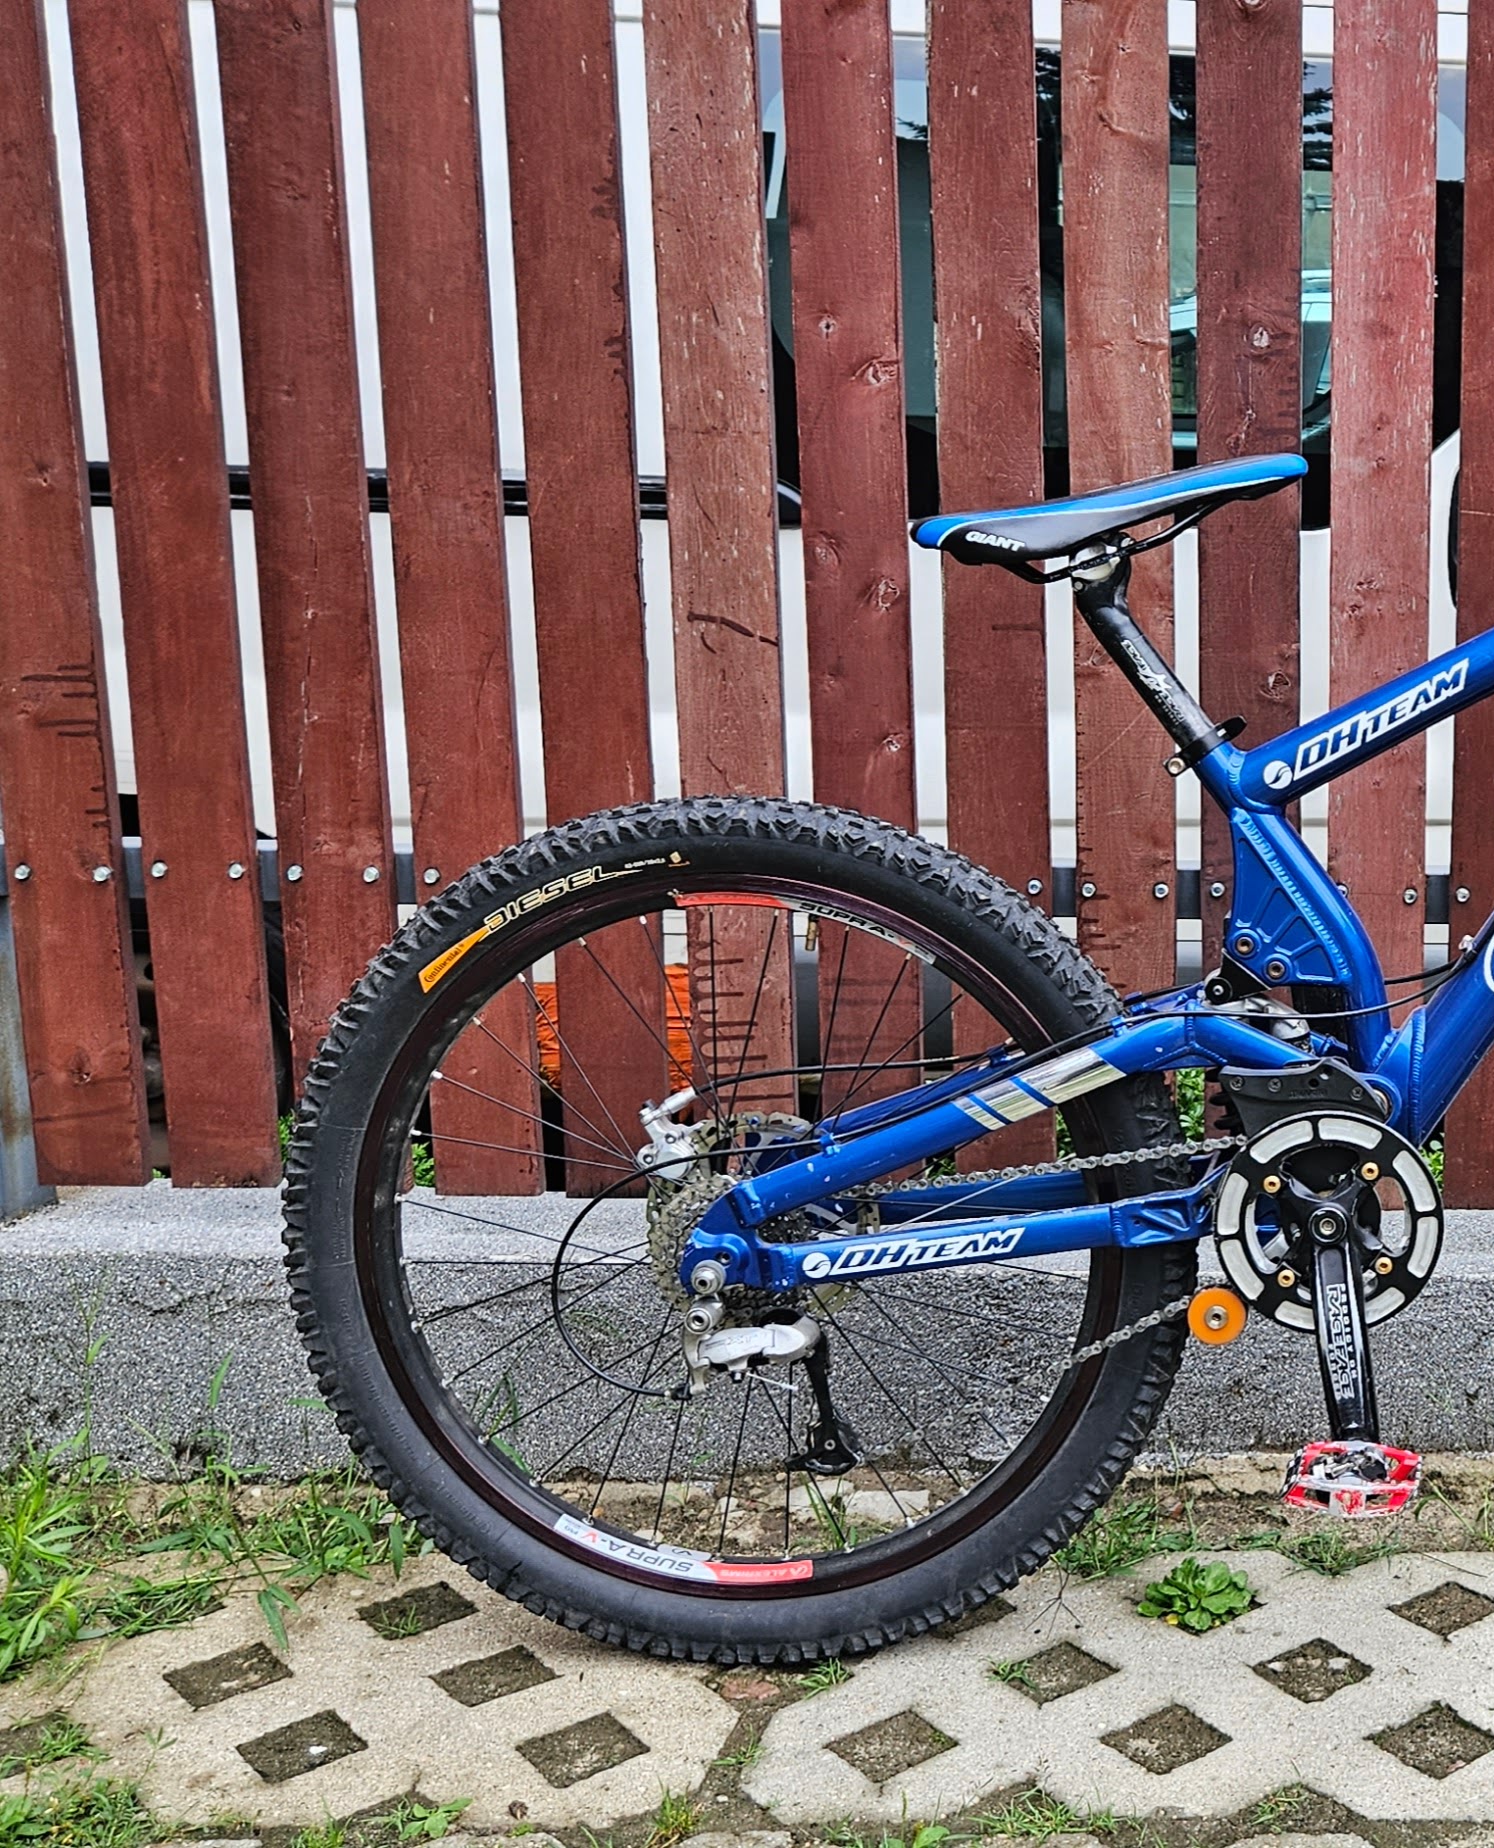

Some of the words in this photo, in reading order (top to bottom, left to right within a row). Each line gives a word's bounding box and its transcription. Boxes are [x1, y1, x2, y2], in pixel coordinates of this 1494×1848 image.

[965, 531, 1026, 552] GIANT
[484, 866, 628, 935] DIESEL
[1339, 1283, 1353, 1352] PRODIGY
